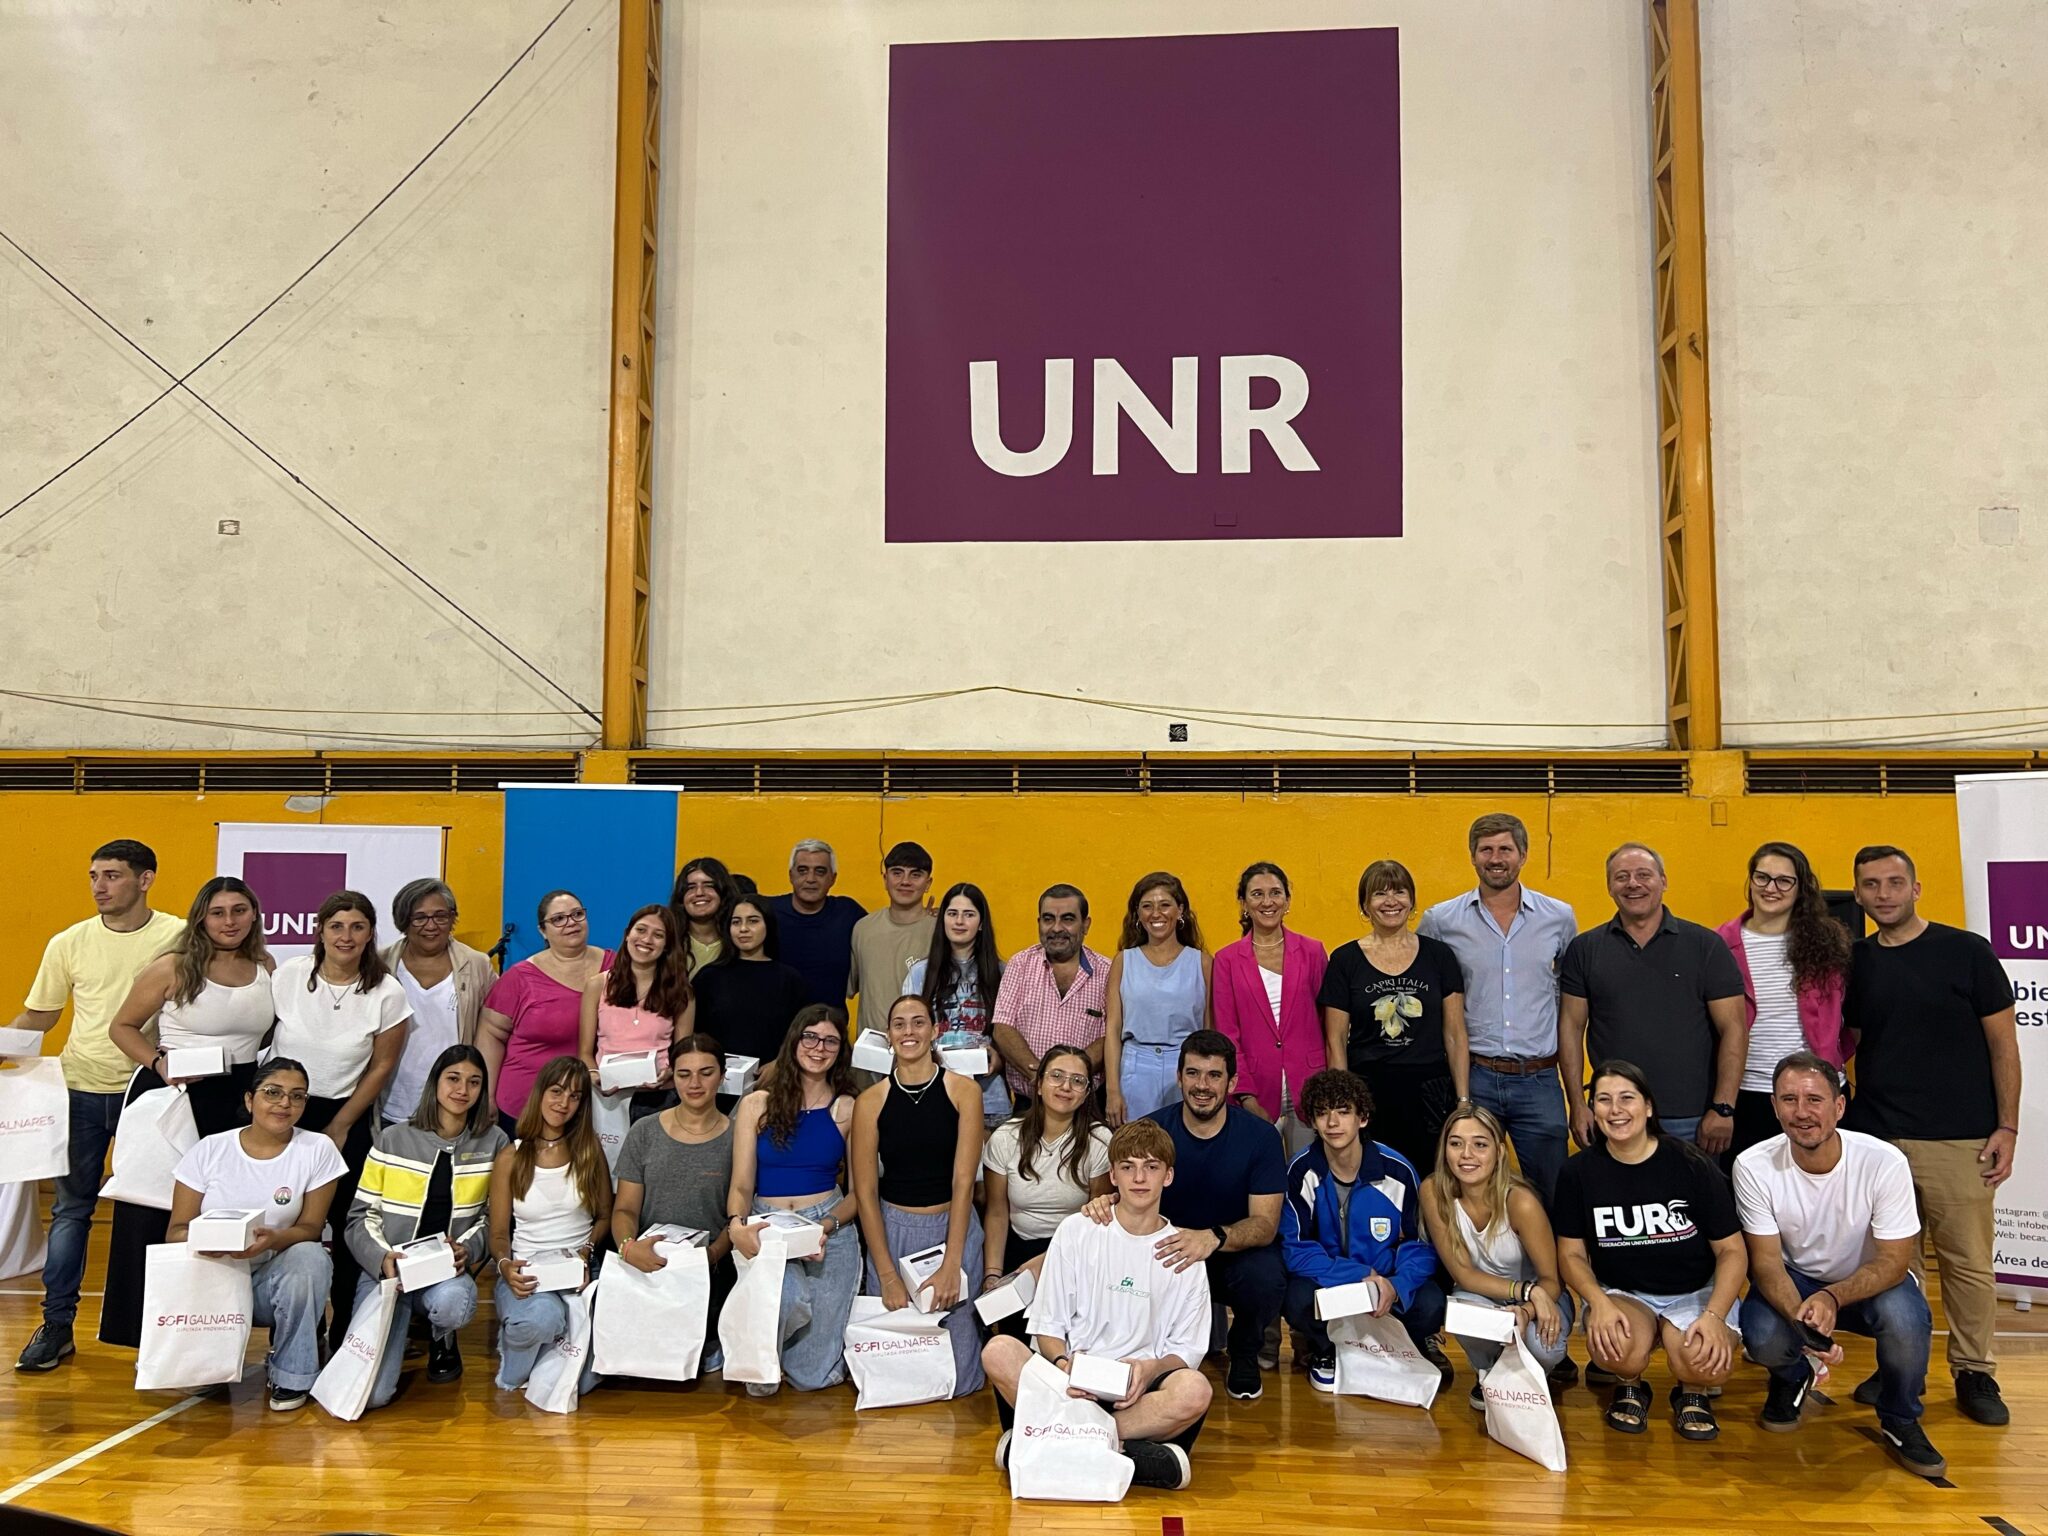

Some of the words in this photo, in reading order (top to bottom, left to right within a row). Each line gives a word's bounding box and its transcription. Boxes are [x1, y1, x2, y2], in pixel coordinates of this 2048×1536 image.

[969, 354, 1321, 477] UNR
[1365, 978, 1396, 993] CAPRI
[1398, 977, 1429, 991] ITALIA
[1995, 1207, 2040, 1217] nstagram:
[1993, 1250, 2027, 1267] Área
[2031, 1256, 2048, 1269] de
[157, 1315, 188, 1326] SOFI
[189, 1313, 246, 1326] GALNARES
[854, 1341, 880, 1353] SOFI
[882, 1336, 941, 1350] GALNARES
[1485, 1387, 1547, 1406] GALNARES
[1024, 1425, 1053, 1438] SOFI
